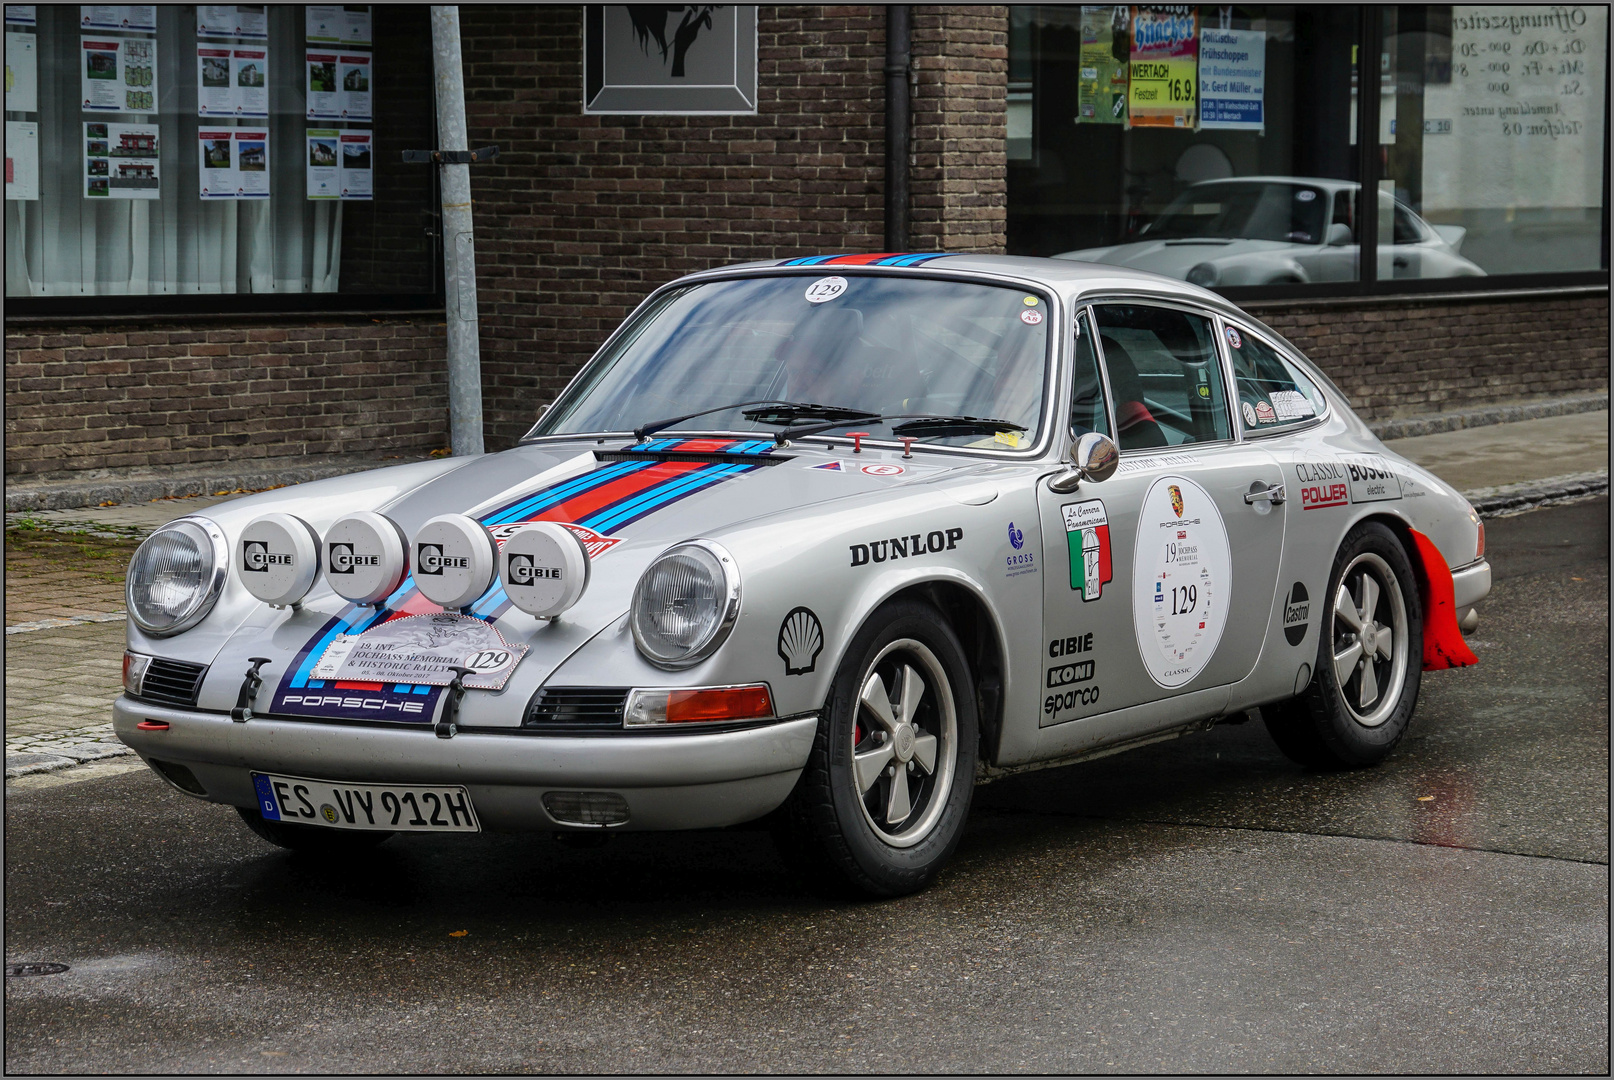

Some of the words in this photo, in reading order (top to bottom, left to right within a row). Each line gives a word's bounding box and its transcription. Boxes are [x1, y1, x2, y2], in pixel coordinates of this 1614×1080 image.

[1202, 31, 1238, 44] Politischer
[1201, 47, 1249, 63] Frühschoppen
[1131, 63, 1170, 78] WERTACH
[1201, 66, 1212, 76] mit
[1213, 66, 1262, 78] Bundesminister
[1168, 78, 1195, 102] 16.9.
[1201, 80, 1211, 92] Dr.
[1212, 80, 1228, 92] Gerd
[1134, 87, 1159, 101] Festzelt
[808, 284, 842, 296] 129
[1296, 461, 1344, 483] CLASSIC
[1349, 457, 1394, 482] BOSCH
[1301, 483, 1348, 504] POWER
[1366, 484, 1386, 496] electric
[1068, 507, 1077, 518] La
[1077, 506, 1101, 518] Carrera
[1066, 516, 1106, 530] Panamericana
[1159, 518, 1201, 529] PORSCHE
[849, 527, 964, 567] DUNLOP
[1165, 542, 1179, 564] 19.
[1006, 552, 1034, 566] GROSS
[1171, 584, 1197, 616] 129
[1286, 603, 1310, 624] Castrol
[360, 642, 372, 650] 19.
[375, 643, 395, 651] INT.
[1049, 632, 1093, 658] CIBIÉ
[352, 651, 403, 661] JOCHPASS
[404, 654, 459, 665] MEMORIAL
[468, 651, 510, 669] 129
[358, 661, 412, 671] HISTORIC
[1163, 666, 1192, 678] CLASSIC
[1050, 663, 1092, 686] KONI
[282, 696, 424, 713] PORSCHE
[1044, 686, 1100, 719] sparco
[264, 800, 273, 811] D
[273, 781, 317, 819] ES
[333, 788, 376, 825] VY
[380, 791, 474, 827] 912H
